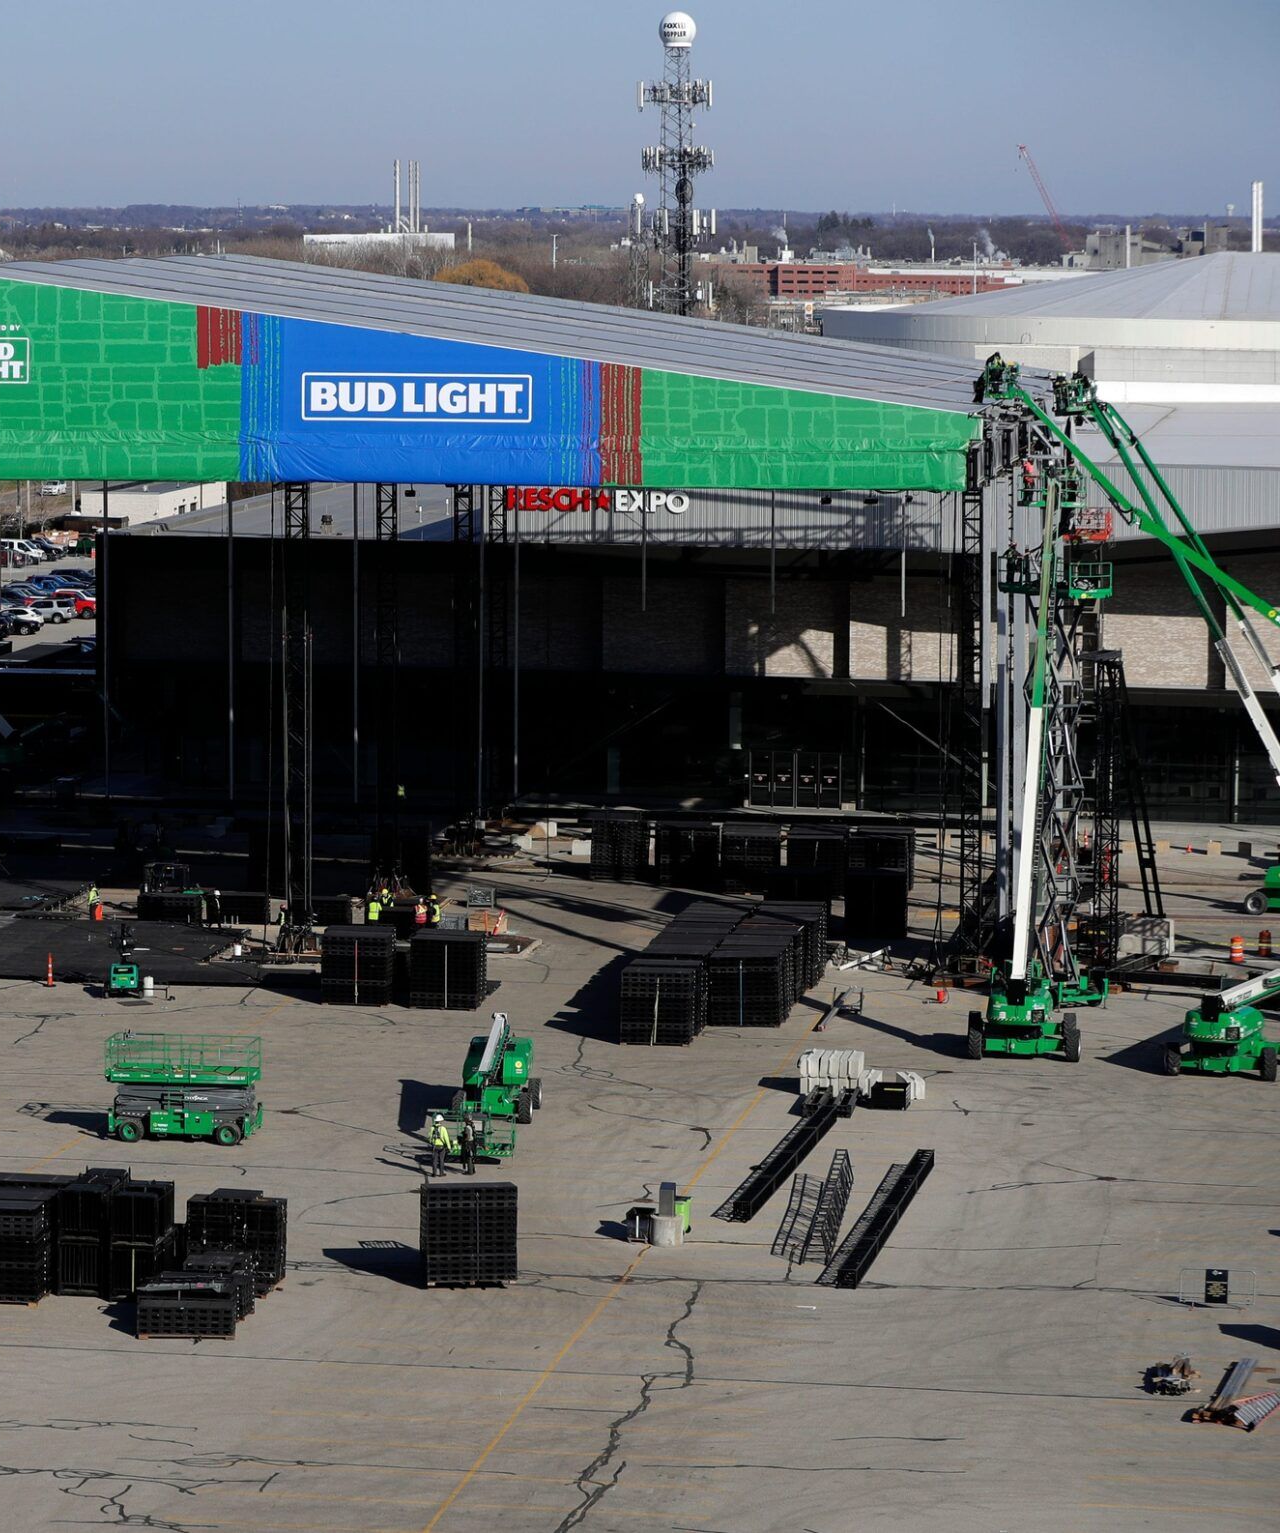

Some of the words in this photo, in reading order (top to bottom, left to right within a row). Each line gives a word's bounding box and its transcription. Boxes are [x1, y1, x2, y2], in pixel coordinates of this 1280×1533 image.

[310, 381, 397, 412] BUD
[402, 382, 523, 414] LIGHT
[506, 487, 590, 512] RESCH
[614, 489, 690, 514] EXPO
